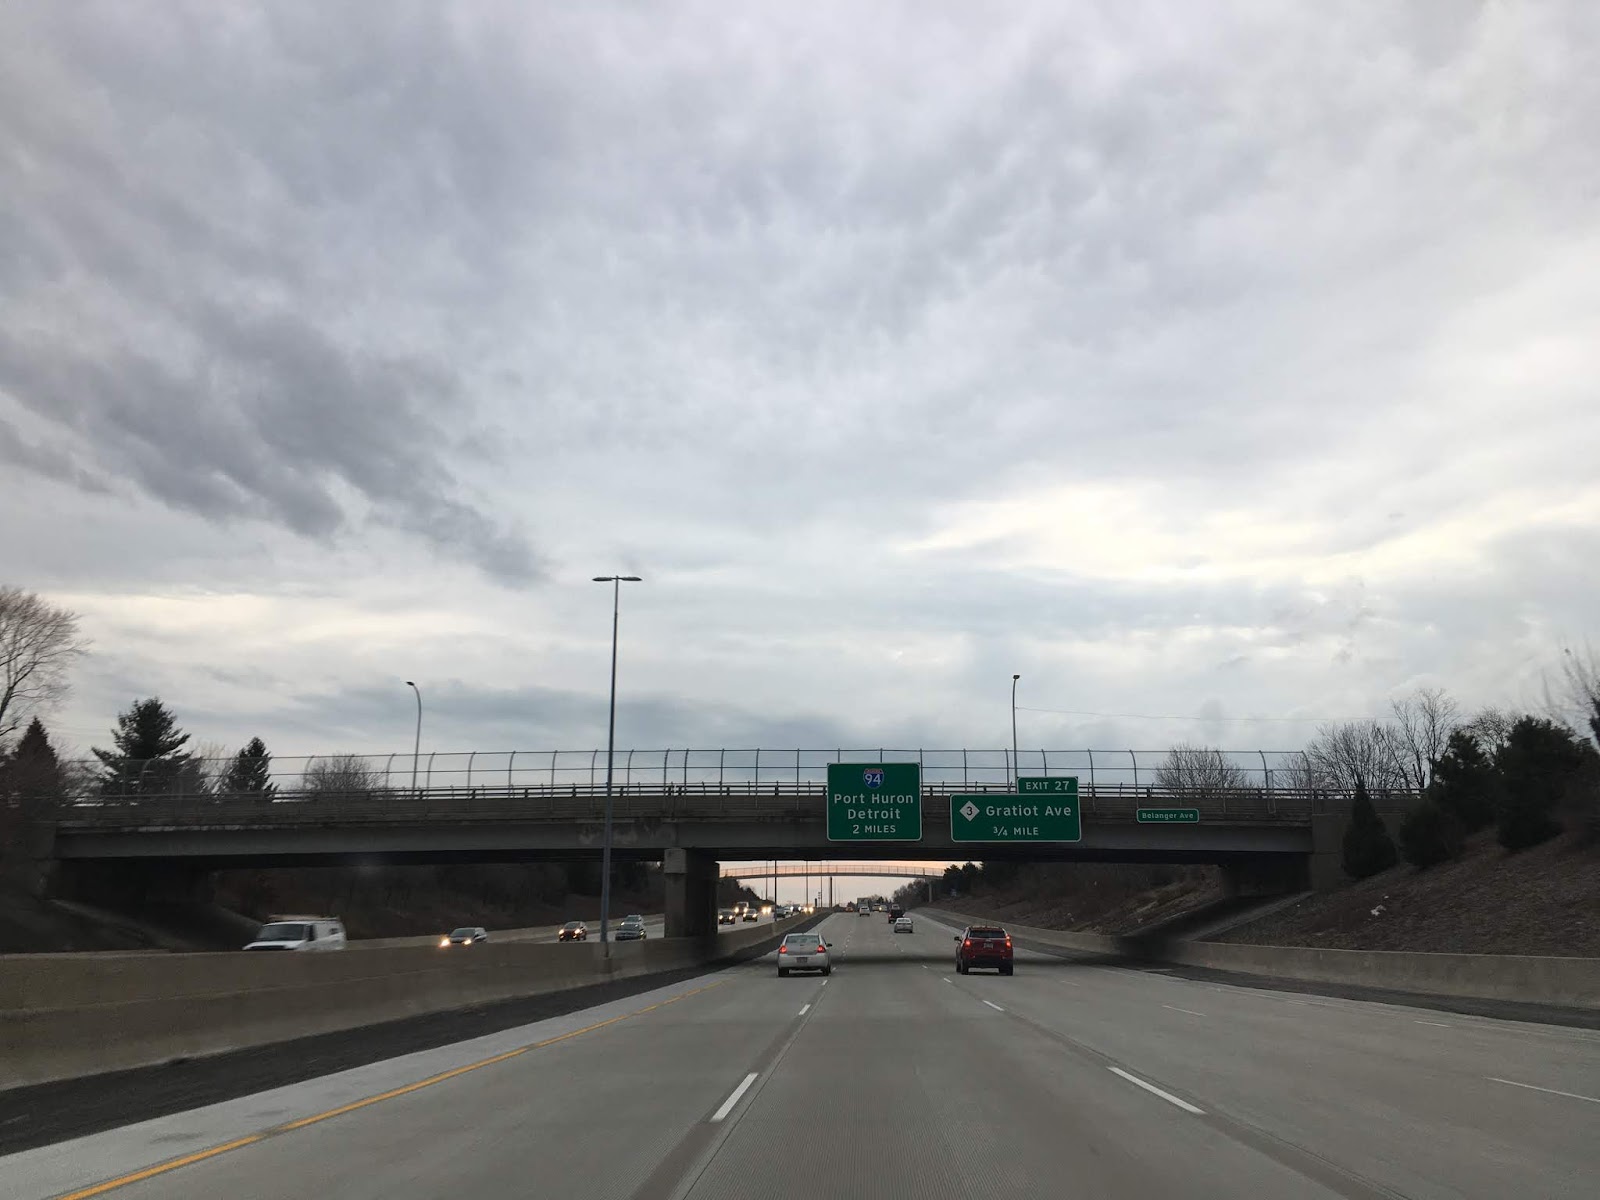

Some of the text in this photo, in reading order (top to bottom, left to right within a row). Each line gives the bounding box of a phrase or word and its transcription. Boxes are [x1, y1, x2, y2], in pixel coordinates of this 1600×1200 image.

[864, 773, 881, 785] 94
[1025, 780, 1070, 791] EXIT 27
[834, 793, 914, 804] Port Huron
[847, 807, 901, 820] Detroit
[966, 806, 973, 816] 3
[985, 804, 1072, 817] Gratiot Ave
[1142, 812, 1177, 820] Belanger
[852, 824, 896, 834] 2 MILES
[1013, 827, 1039, 836] MILE
